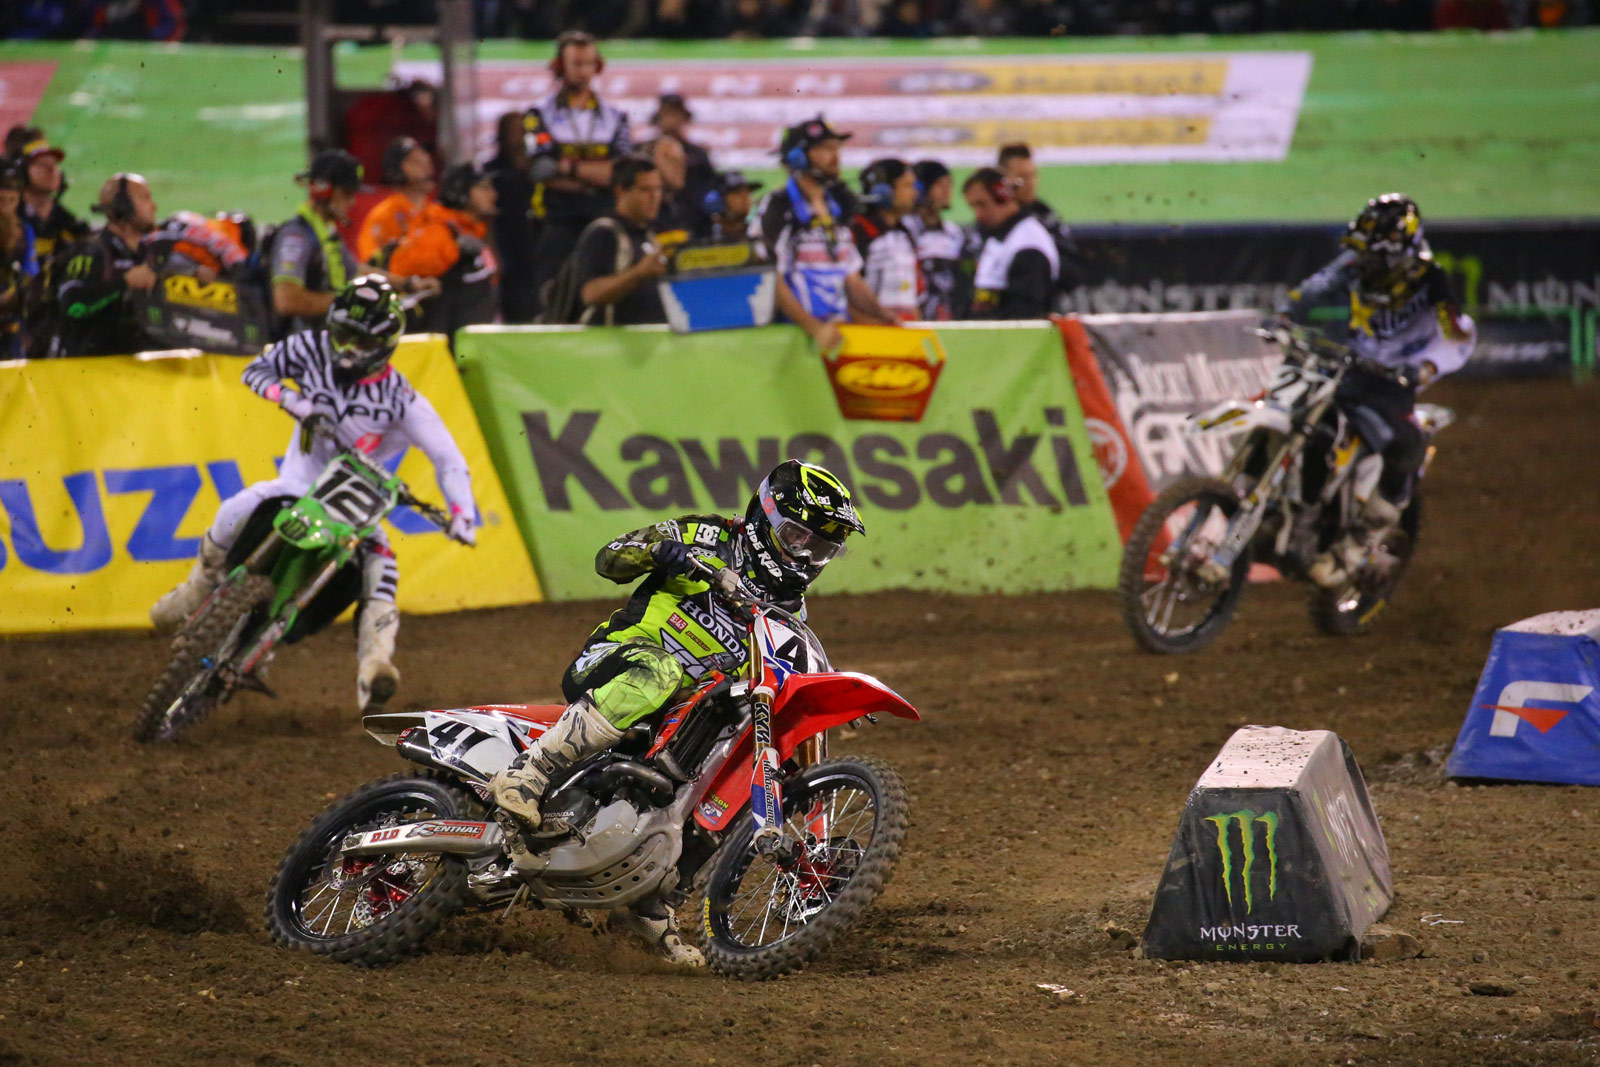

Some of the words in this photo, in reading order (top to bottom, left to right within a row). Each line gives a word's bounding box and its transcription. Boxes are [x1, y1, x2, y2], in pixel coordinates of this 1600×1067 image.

[521, 408, 1091, 511] Kawsaki
[311, 468, 387, 527] 12
[745, 522, 765, 551] RIDE
[681, 600, 748, 664] HONDA
[765, 792, 776, 826] Racing
[703, 896, 715, 938] DUNLOP
[1200, 923, 1302, 941] MONSTER
[1216, 943, 1287, 951] ENERGY
